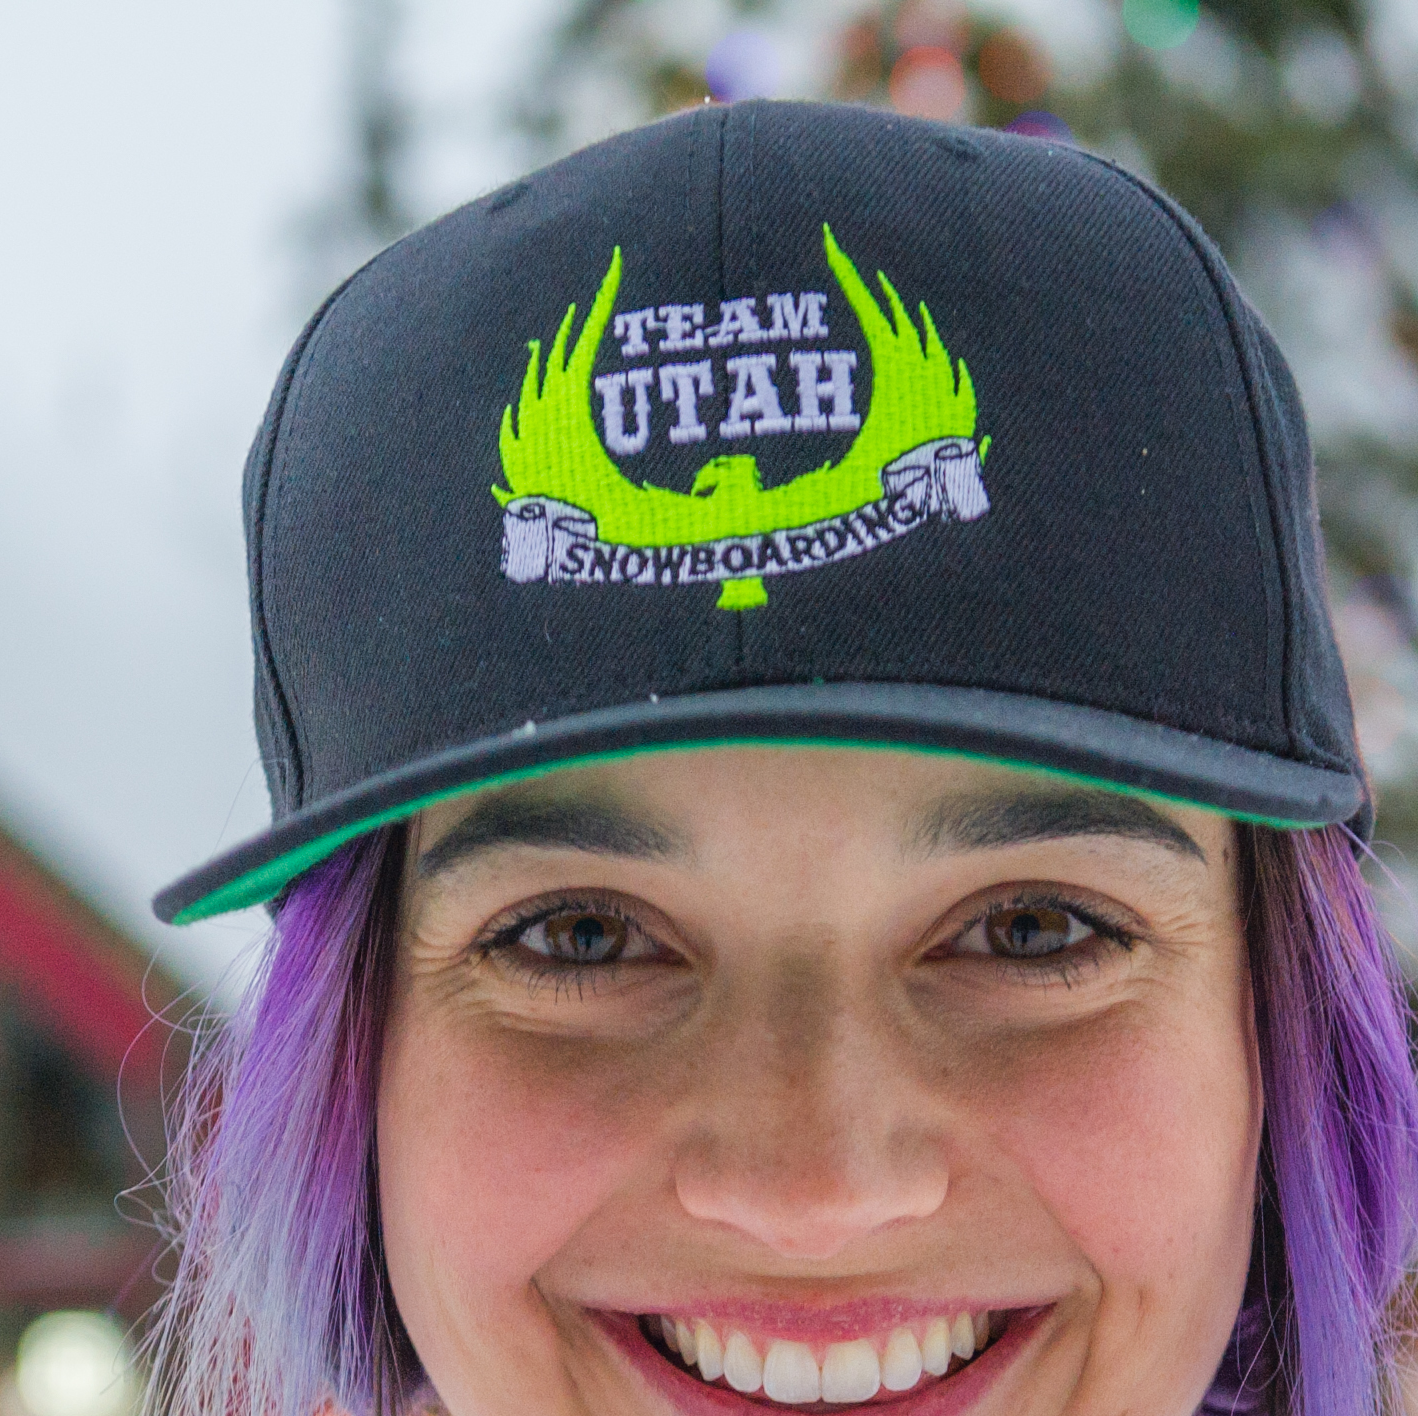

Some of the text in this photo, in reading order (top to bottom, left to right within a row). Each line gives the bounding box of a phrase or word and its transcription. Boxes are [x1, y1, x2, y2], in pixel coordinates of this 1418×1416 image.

[614, 290, 828, 358] TEAM
[594, 349, 861, 456] UTAH
[559, 494, 920, 578] SNOWBOARDING
